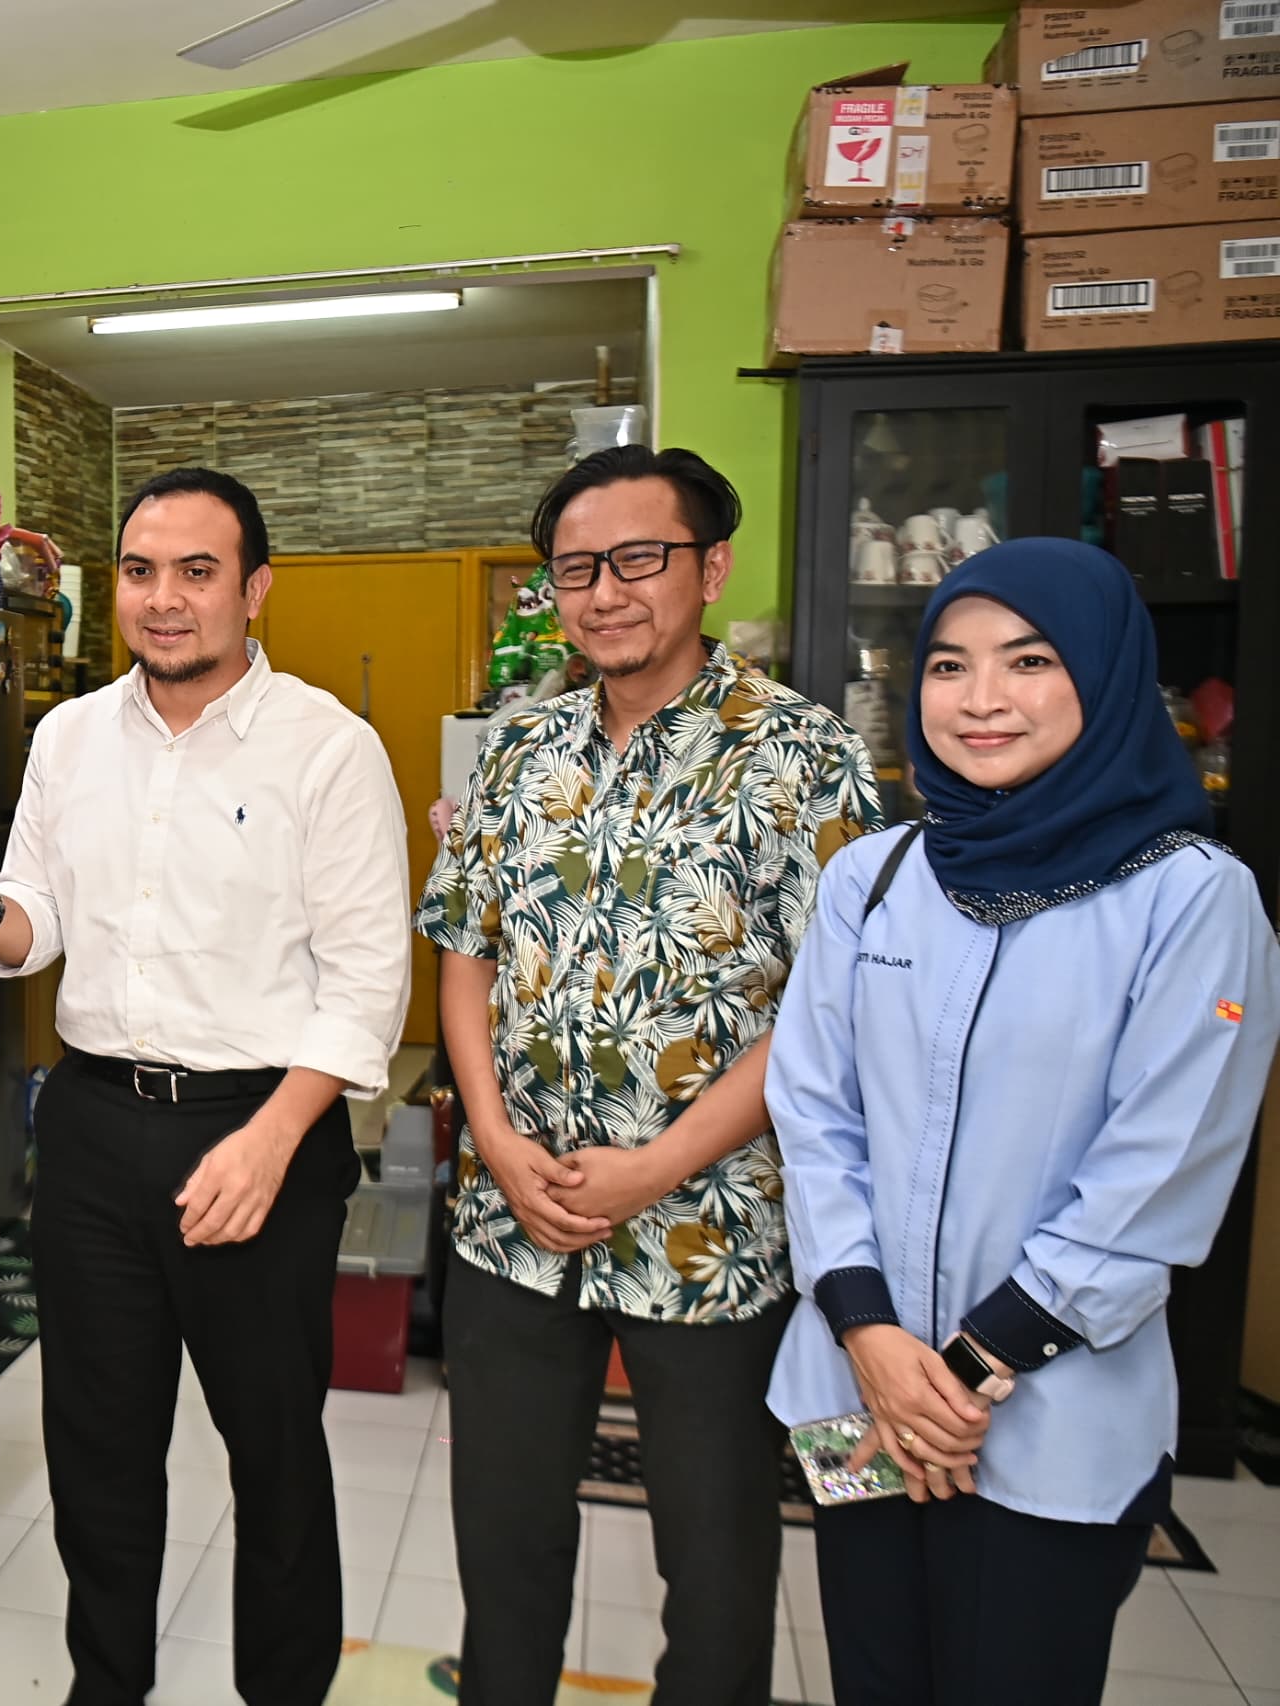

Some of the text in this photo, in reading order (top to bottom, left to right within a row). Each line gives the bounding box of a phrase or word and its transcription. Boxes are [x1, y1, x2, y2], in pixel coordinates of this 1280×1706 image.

[1223, 64, 1280, 79] FRAGILE
[840, 103, 887, 114] FRAGILE
[1218, 190, 1279, 202] FRAGILE
[871, 953, 913, 970] HAJAR
